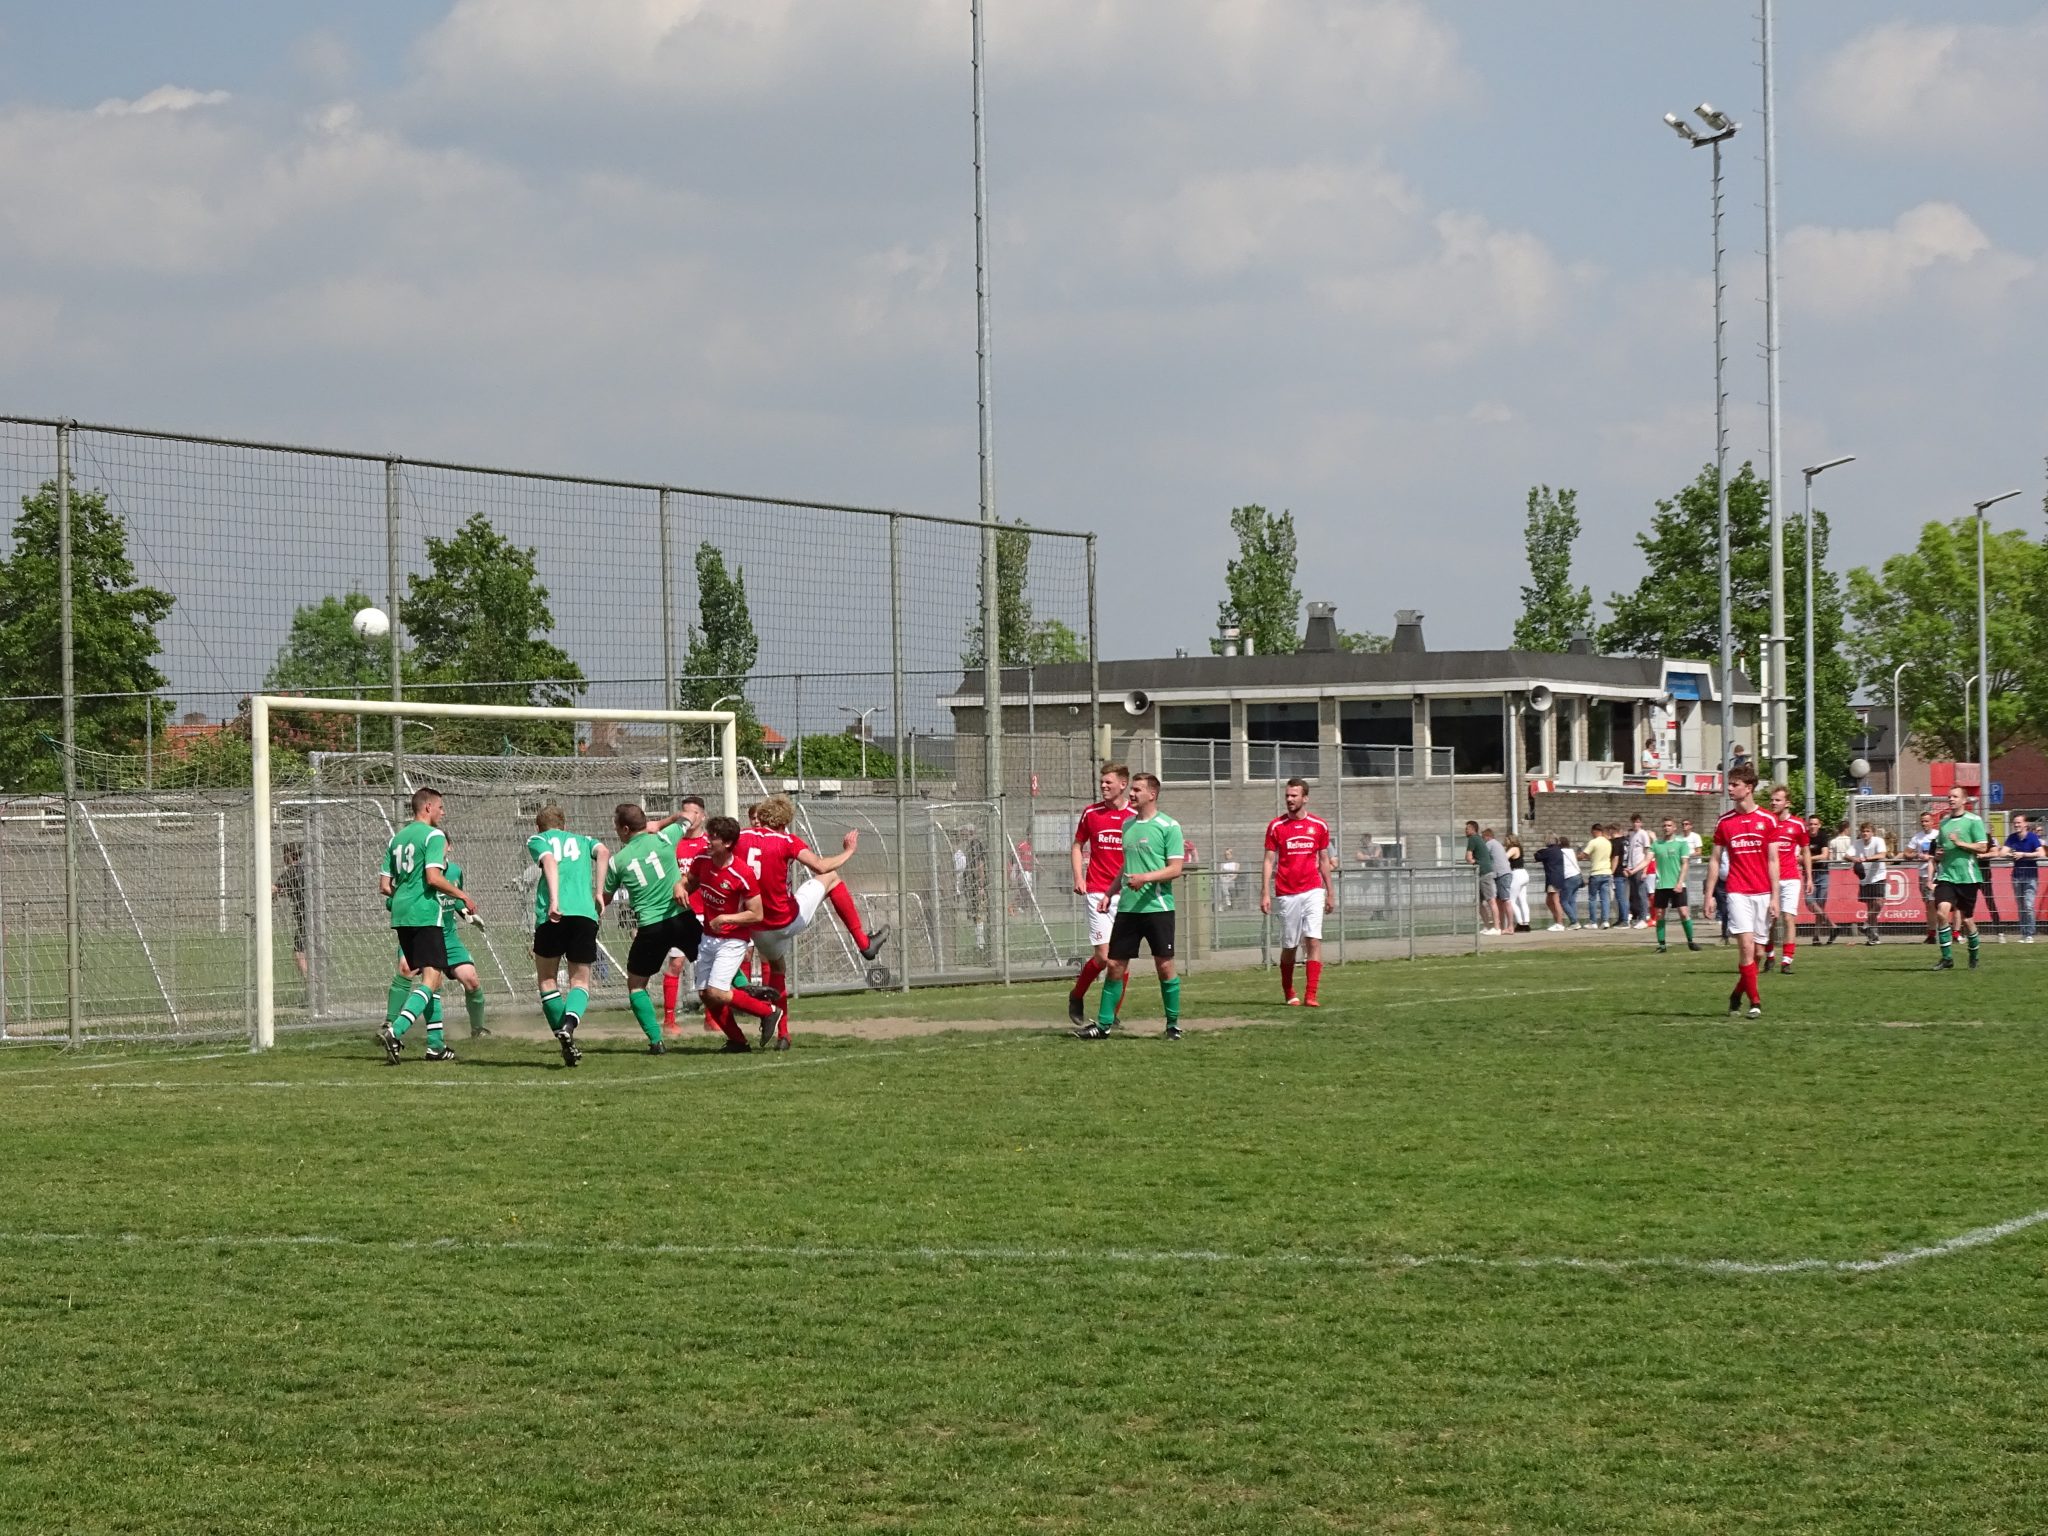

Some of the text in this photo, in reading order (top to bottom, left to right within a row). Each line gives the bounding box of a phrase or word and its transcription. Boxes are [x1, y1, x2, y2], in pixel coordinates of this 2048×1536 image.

[393, 843, 415, 874] 13
[548, 837, 581, 862] 14
[747, 847, 762, 880] 5
[626, 850, 666, 887] 11
[1884, 909, 1921, 919] GROEP
